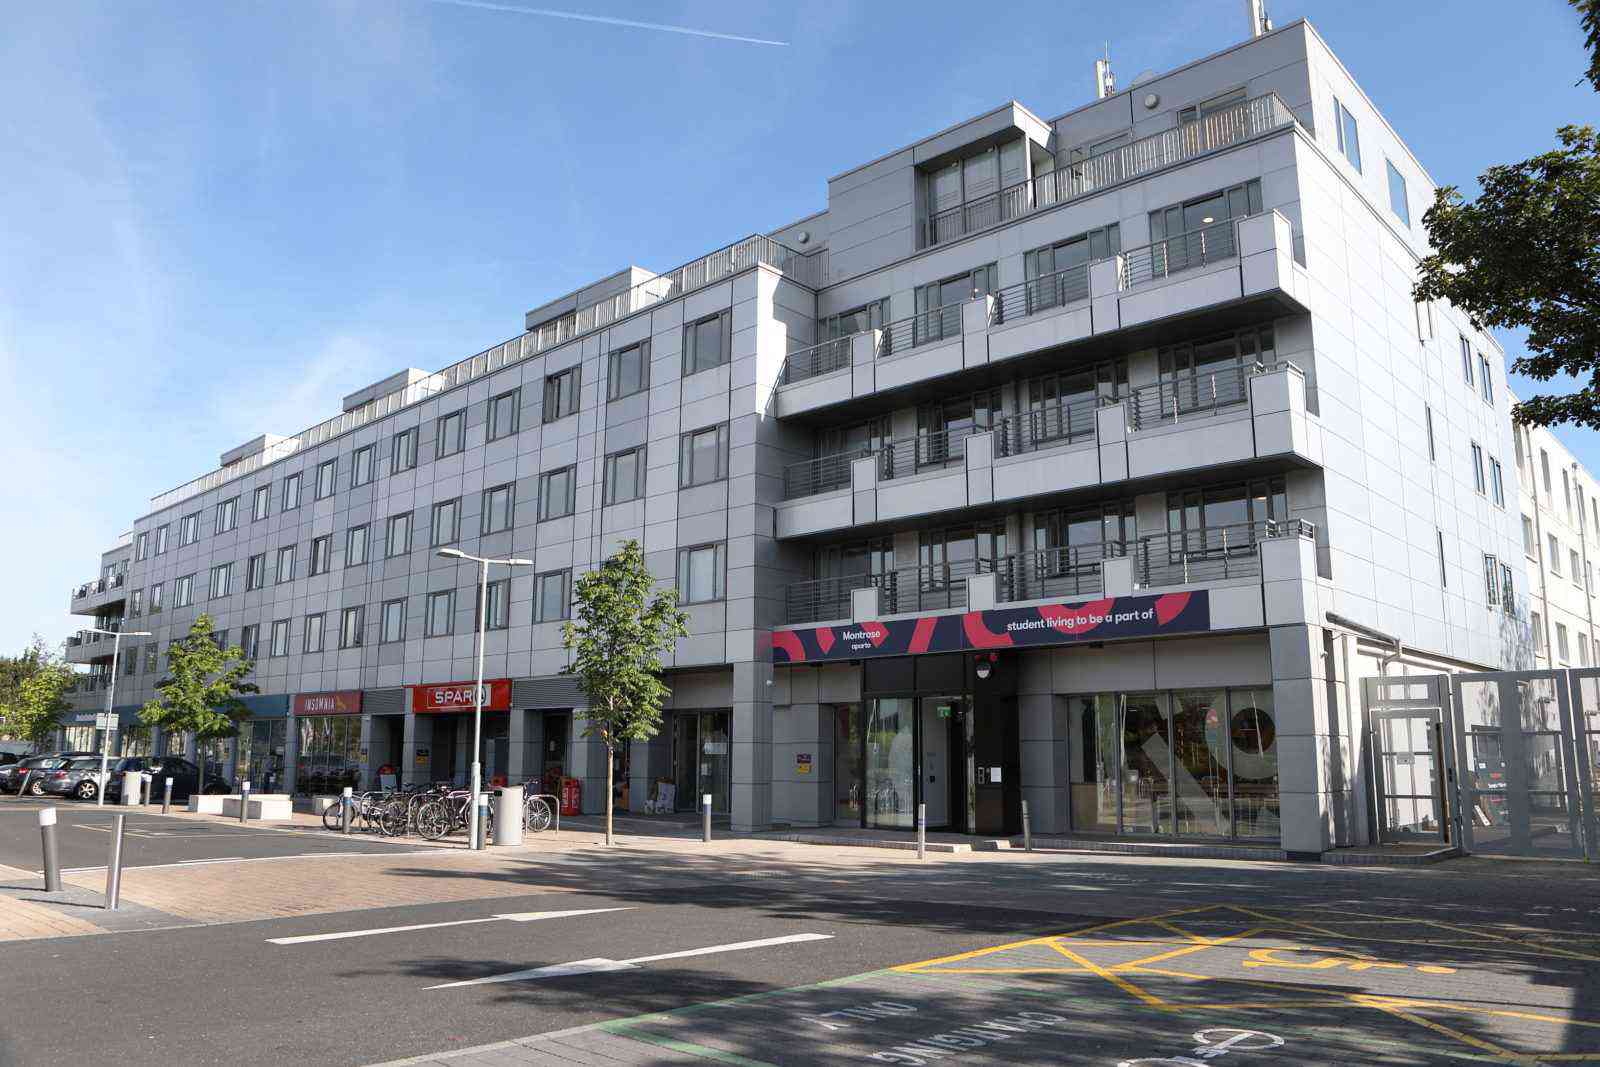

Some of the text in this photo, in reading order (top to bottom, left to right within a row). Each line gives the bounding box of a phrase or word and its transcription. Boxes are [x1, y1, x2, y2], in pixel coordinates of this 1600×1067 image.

[1007, 607, 1155, 632] student living to be a part of
[842, 629, 881, 642] Montrose
[851, 642, 872, 652] aparto
[304, 696, 336, 712] INSOMNIA
[434, 689, 473, 704] SPAR
[800, 1001, 918, 1031] ONLY
[868, 1011, 1068, 1067] CHARGING
